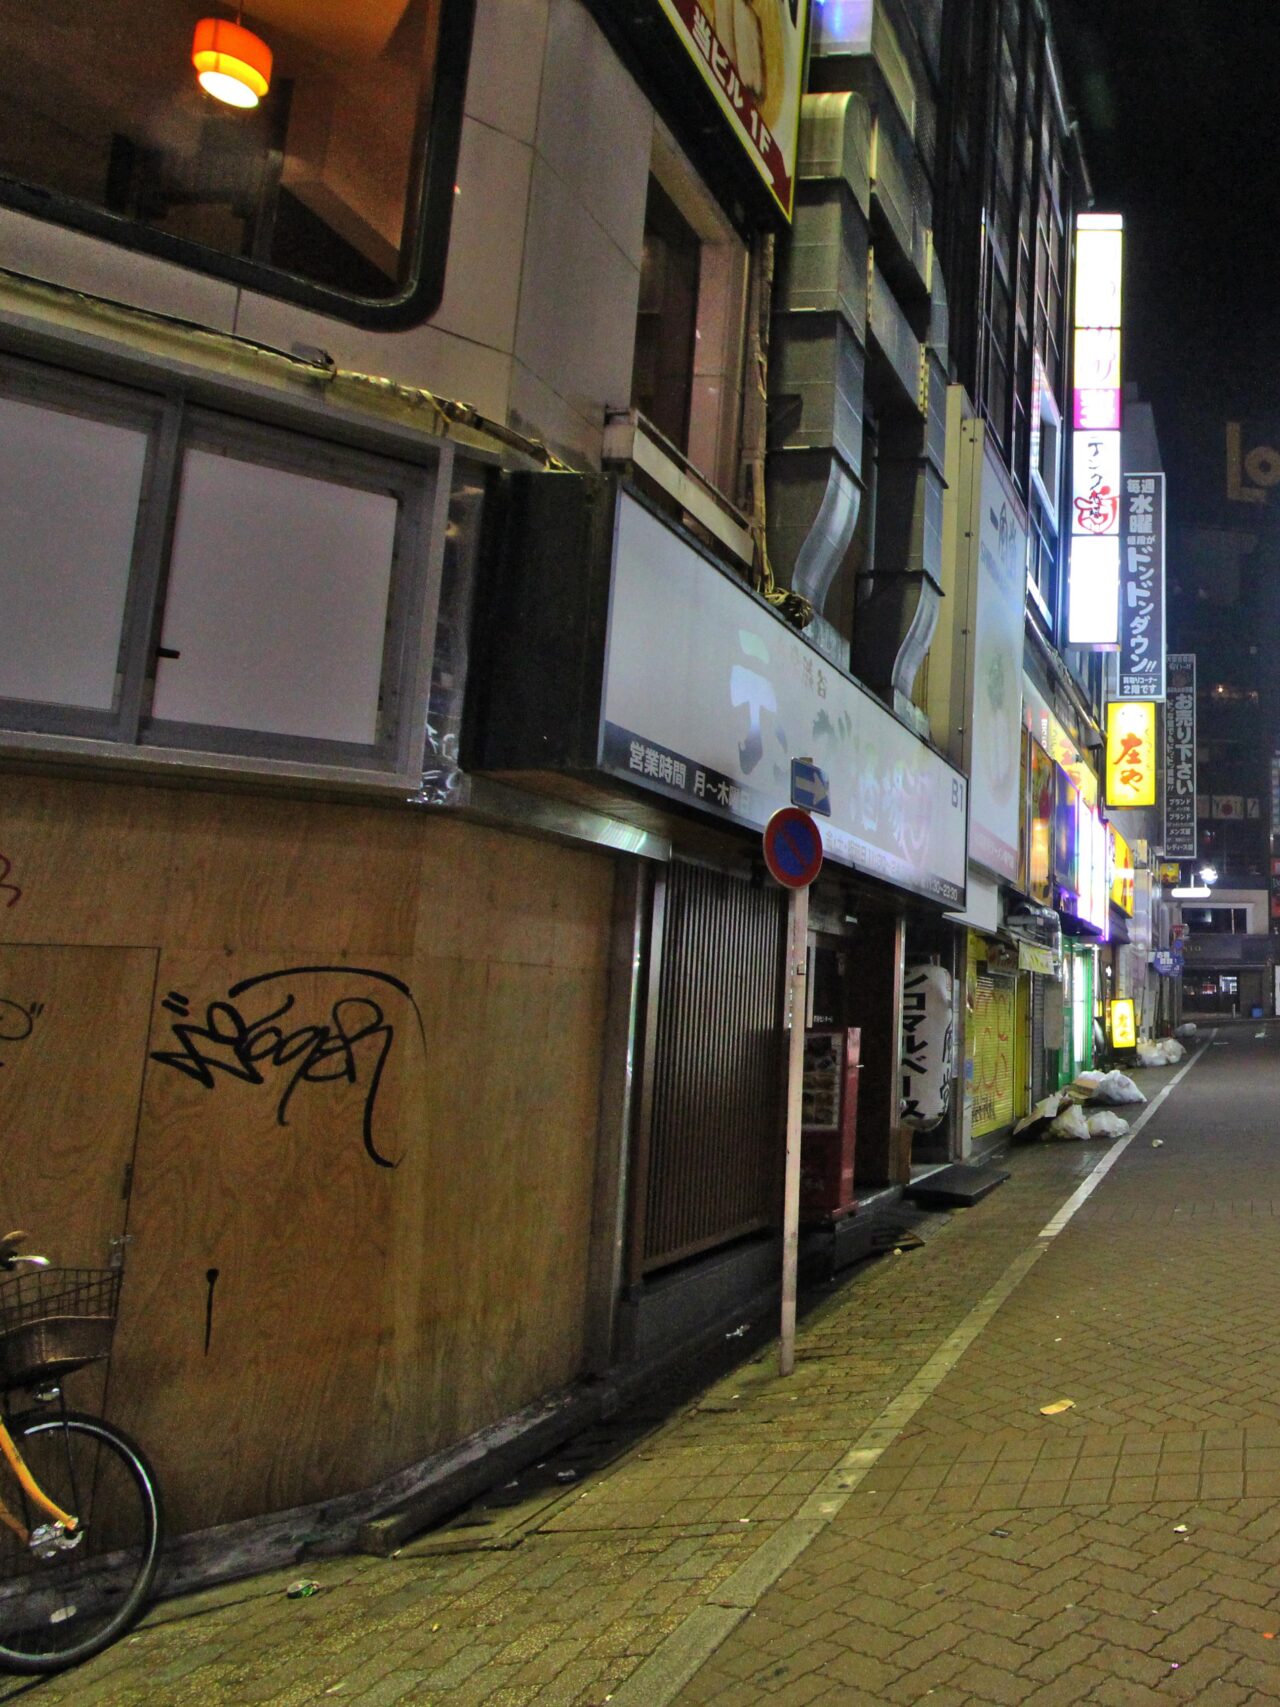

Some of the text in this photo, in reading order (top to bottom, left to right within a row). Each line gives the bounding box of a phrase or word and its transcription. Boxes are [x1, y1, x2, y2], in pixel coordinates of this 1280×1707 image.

[750, 109, 772, 154] 1F
[1128, 495, 1154, 534] 水曜
[628, 741, 687, 789] 営業時間
[1113, 732, 1144, 792] 庄や
[1174, 693, 1195, 796] お売り下さい
[952, 778, 963, 812] B1
